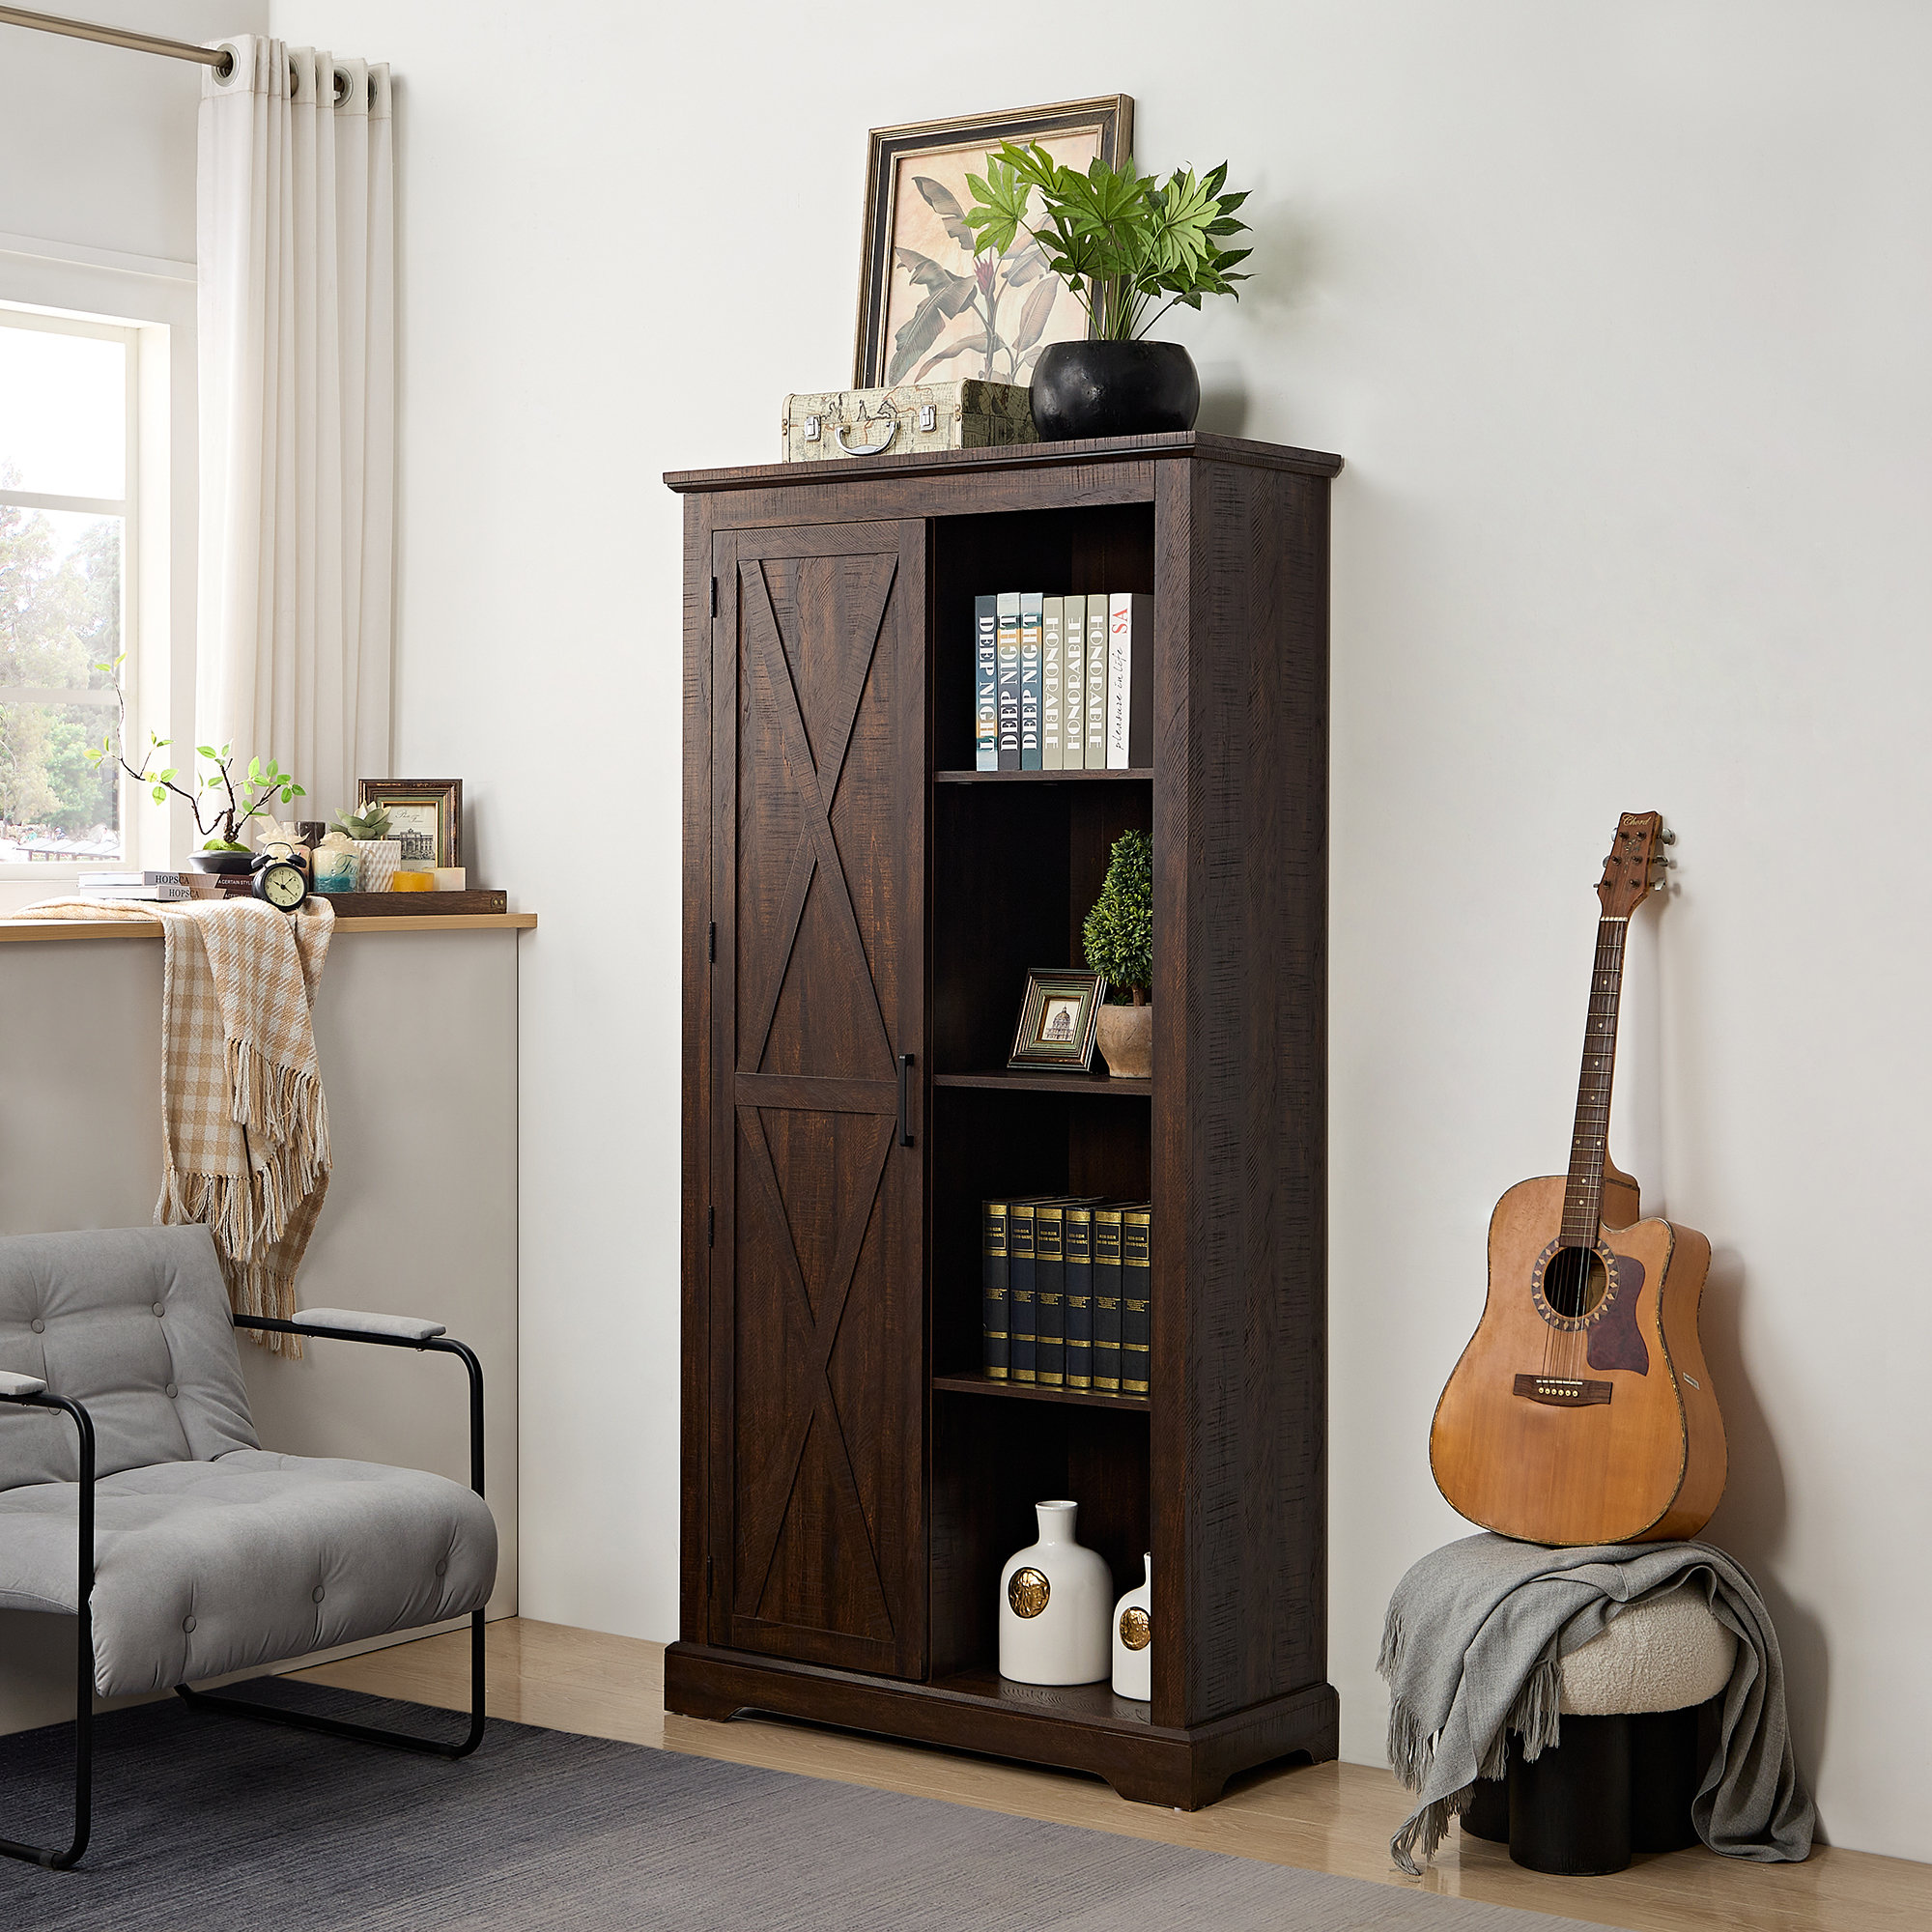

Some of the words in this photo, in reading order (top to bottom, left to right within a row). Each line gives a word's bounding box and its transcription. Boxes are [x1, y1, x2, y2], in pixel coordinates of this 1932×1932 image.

[979, 615, 995, 676] DEEP
[1000, 613, 1018, 685] NIGHT
[1022, 611, 1037, 684] NIGHT
[1112, 609, 1128, 635] SA
[1044, 617, 1060, 750] HONORABLE
[1066, 616, 1082, 750] HONORABLE
[1089, 615, 1104, 749] HONORABLE
[1113, 646, 1127, 672] life
[1114, 674, 1123, 689] in
[979, 681, 995, 753] NIGHT
[1000, 691, 1018, 752] DEEP
[1022, 689, 1037, 751] DEEP
[1112, 693, 1124, 750] pleasure
[156, 874, 190, 885] HOPSCA
[169, 889, 200, 898] HOPSCA
